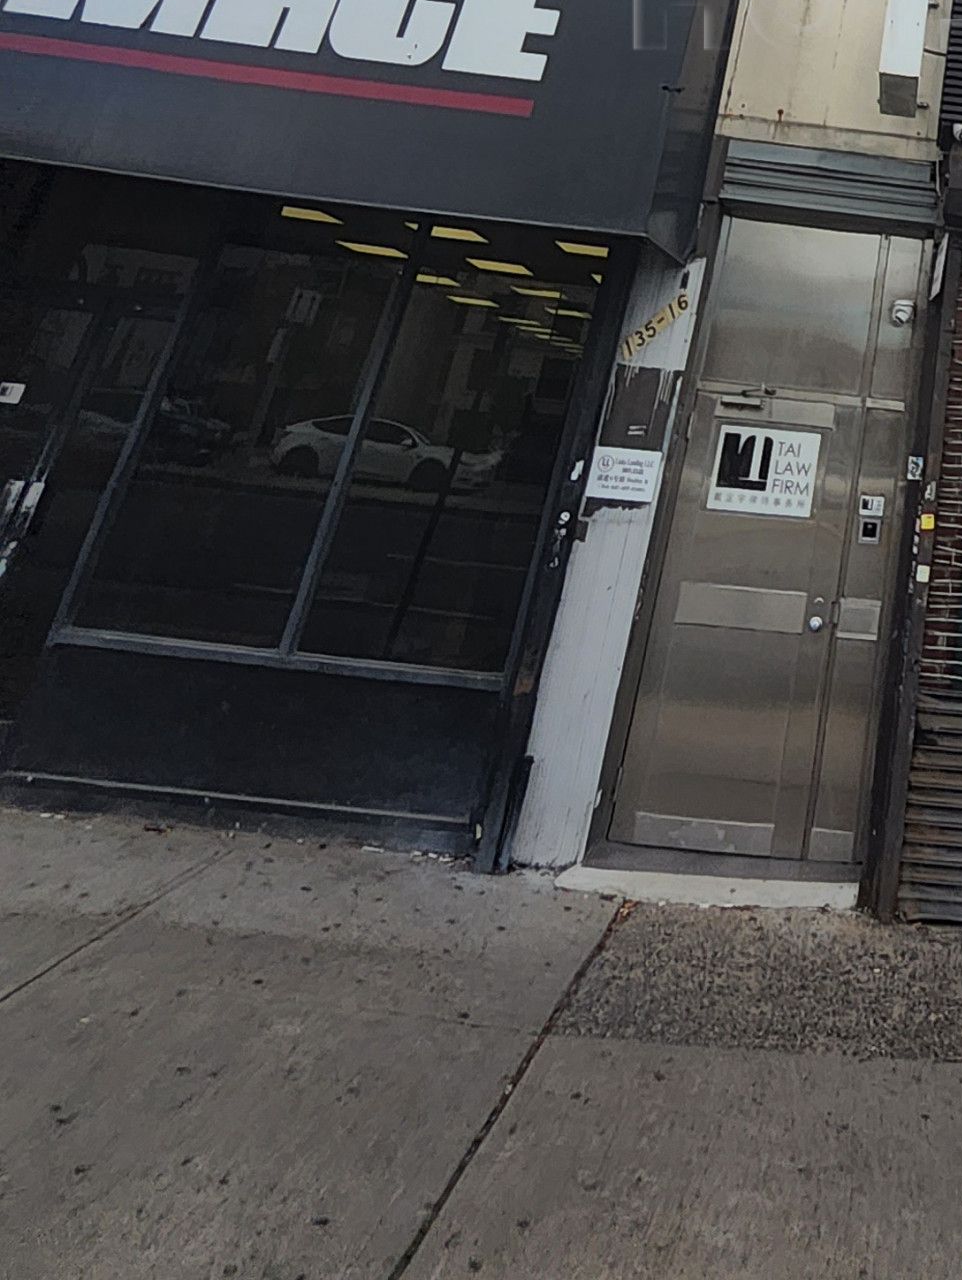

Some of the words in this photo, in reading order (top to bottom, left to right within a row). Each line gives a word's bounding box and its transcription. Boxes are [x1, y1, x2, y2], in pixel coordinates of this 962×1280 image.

[625, 294, 688, 356] 135-16
[778, 441, 801, 457] TAI
[774, 460, 812, 476] LAW
[771, 479, 809, 496] FIRM
